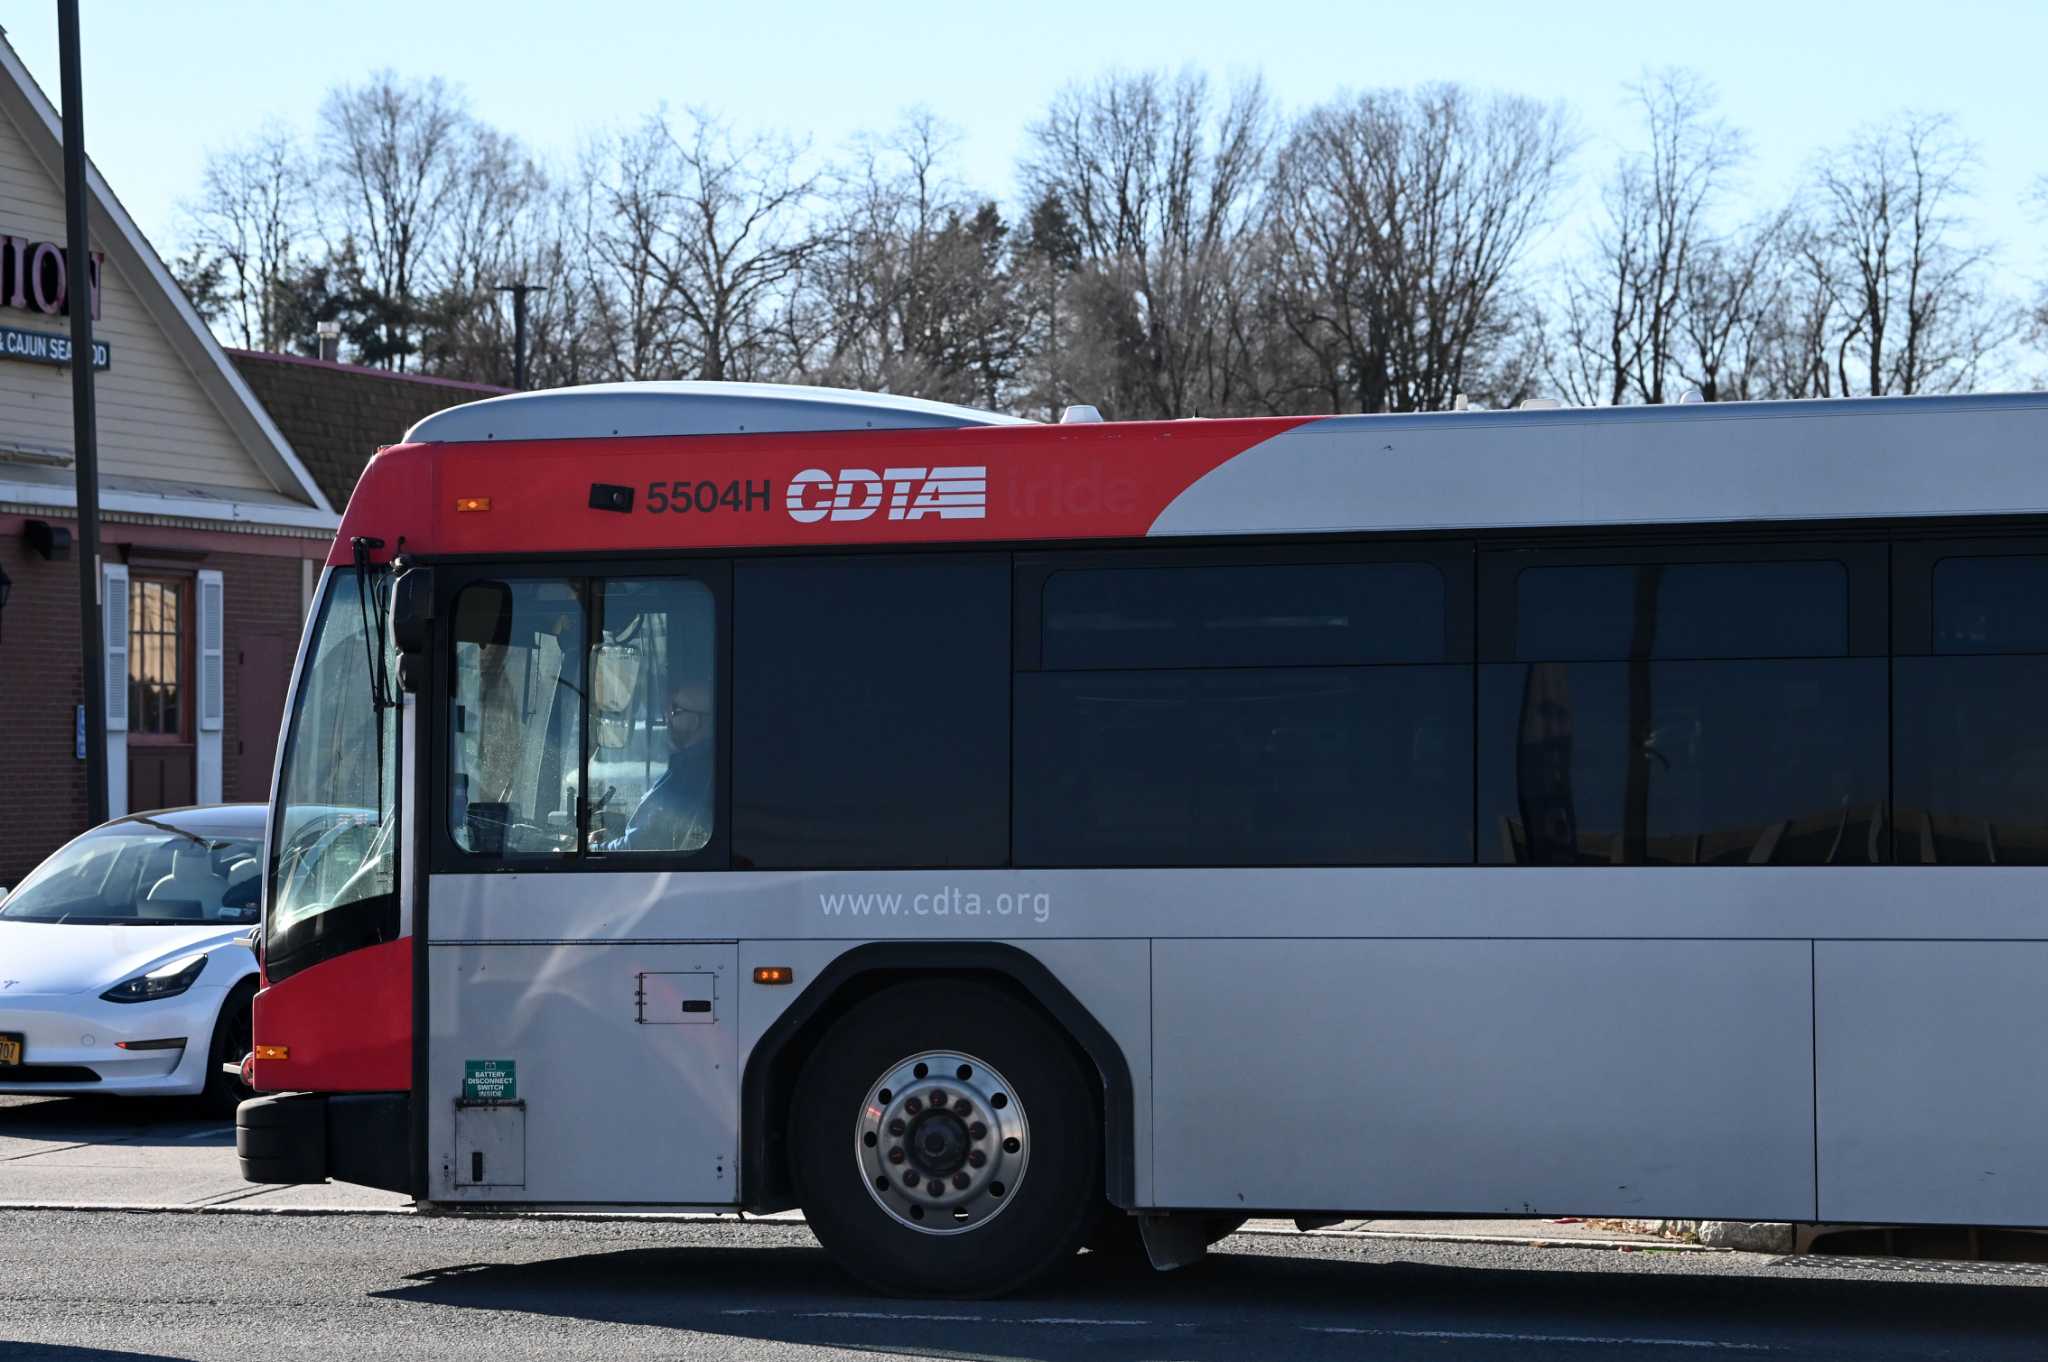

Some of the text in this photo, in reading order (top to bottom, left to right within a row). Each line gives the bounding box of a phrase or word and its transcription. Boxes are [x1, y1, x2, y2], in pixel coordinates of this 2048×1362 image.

[0, 236, 104, 321] IO
[7, 332, 46, 357] CAJUN
[646, 479, 771, 514] 5504H
[786, 466, 986, 523] CDTA
[819, 885, 1050, 923] www.cdta.org
